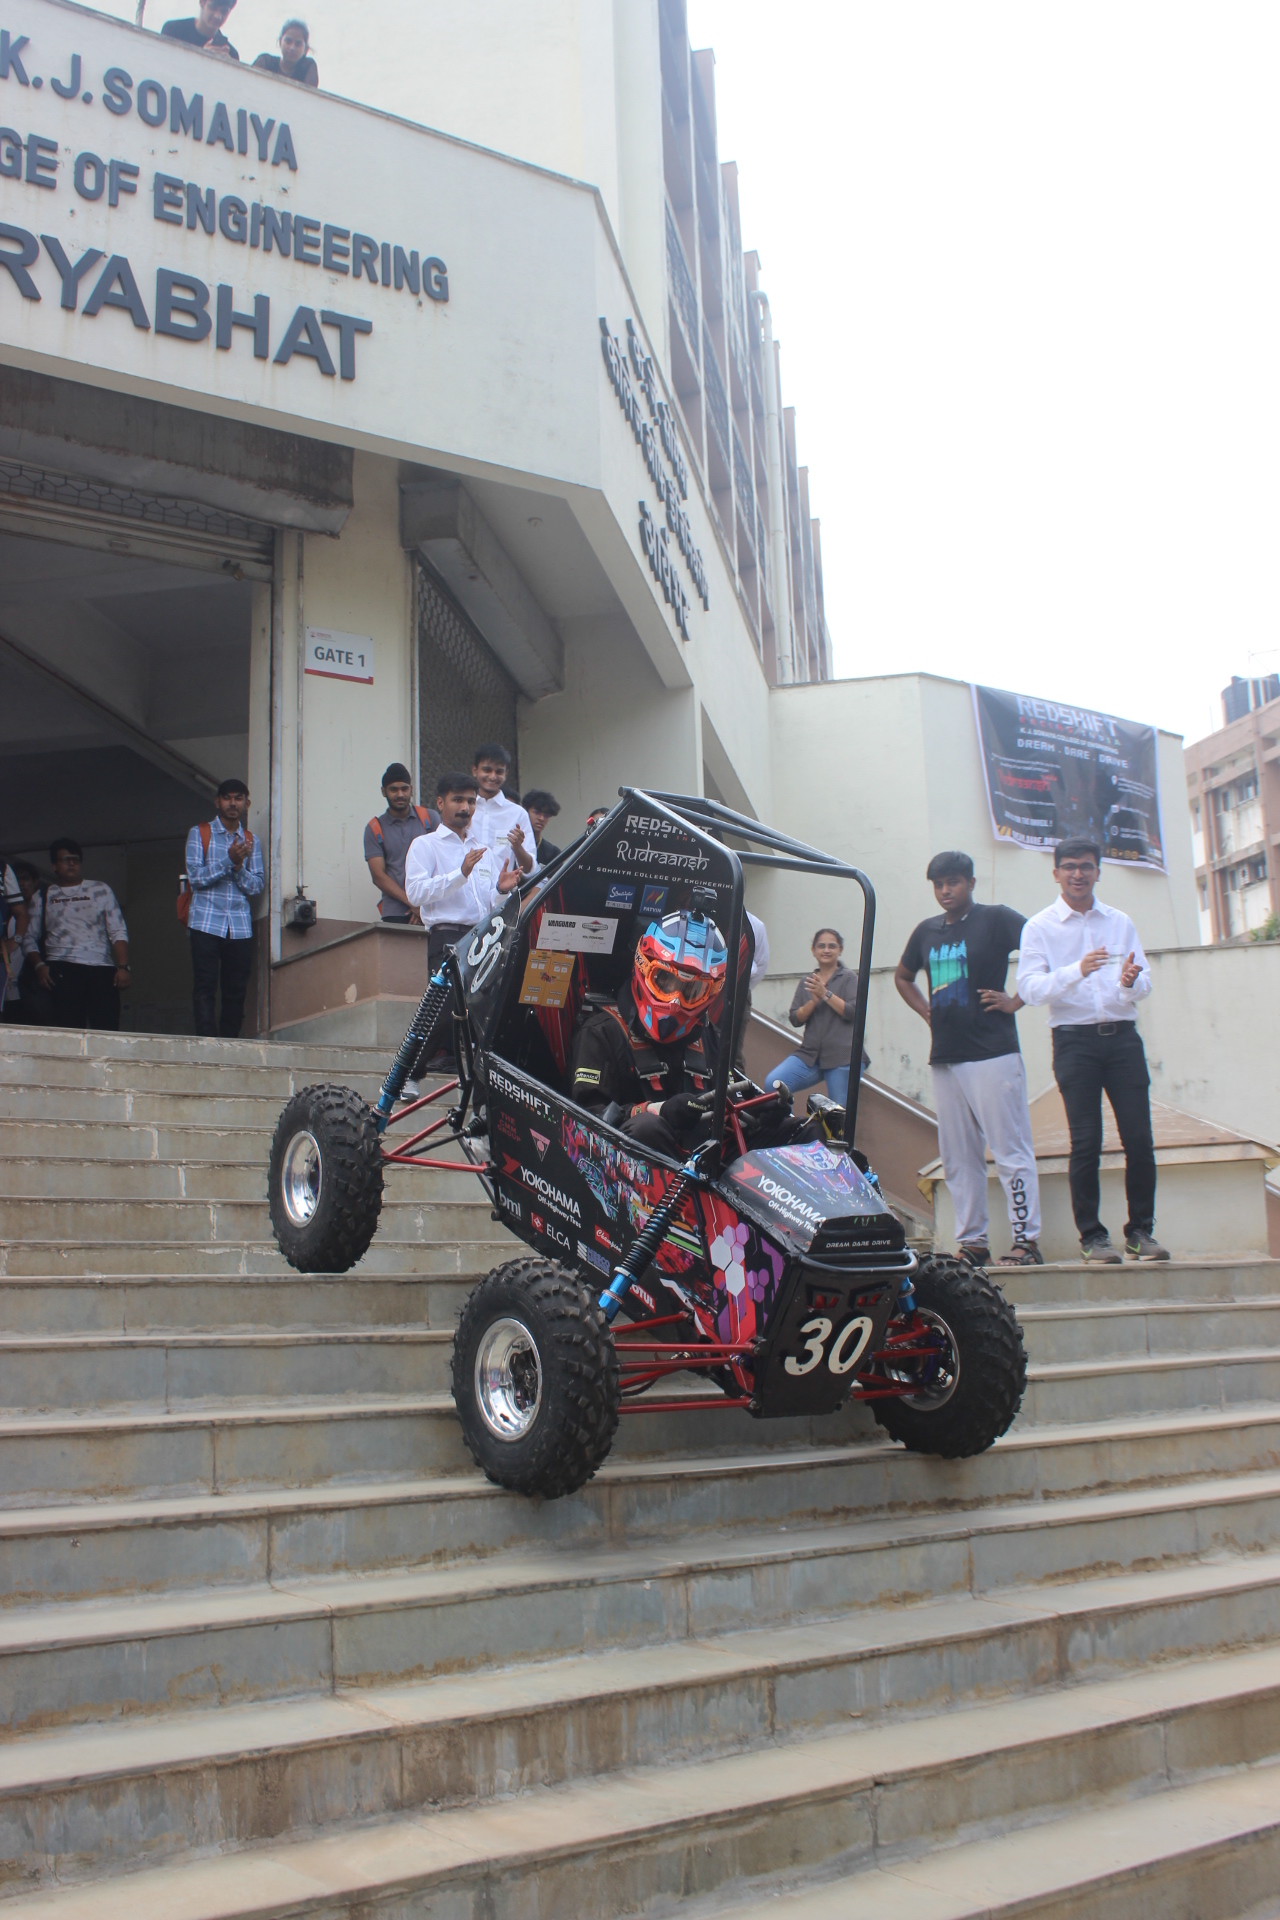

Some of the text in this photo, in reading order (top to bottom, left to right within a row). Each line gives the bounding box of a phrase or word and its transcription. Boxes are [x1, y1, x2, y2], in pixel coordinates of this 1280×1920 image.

[74, 152, 139, 207] OF
[153, 171, 449, 302] ENGINEERING
[314, 646, 365, 667] GATE 1
[1016, 696, 1117, 737] REDSHIFT
[1020, 716, 1073, 733] RACING
[1017, 738, 1128, 769] DREAM DARE DRIVE
[625, 828, 668, 839] RACING
[617, 840, 710, 871] Rudraansh
[597, 867, 632, 876] SOMAIYA
[634, 872, 669, 881] COLLEGE
[606, 901, 632, 909] TRUST
[548, 919, 577, 929] VANGUARD
[467, 916, 504, 994] 30
[489, 1069, 550, 1115] REDSHIFT
[497, 1124, 521, 1142] GROUP
[500, 1110, 515, 1125] THE
[500, 1119, 516, 1134] CMM
[499, 1186, 522, 1217] bmi
[521, 1166, 581, 1218] YOKOHAMA
[756, 1175, 827, 1228] YOKOHAMA
[537, 1194, 581, 1228] Off-Highway Tires
[768, 1199, 818, 1235] Off-Highway Tires
[546, 1222, 570, 1250] ELCA
[630, 1284, 655, 1310] OTUL
[785, 1316, 873, 1376] 30
